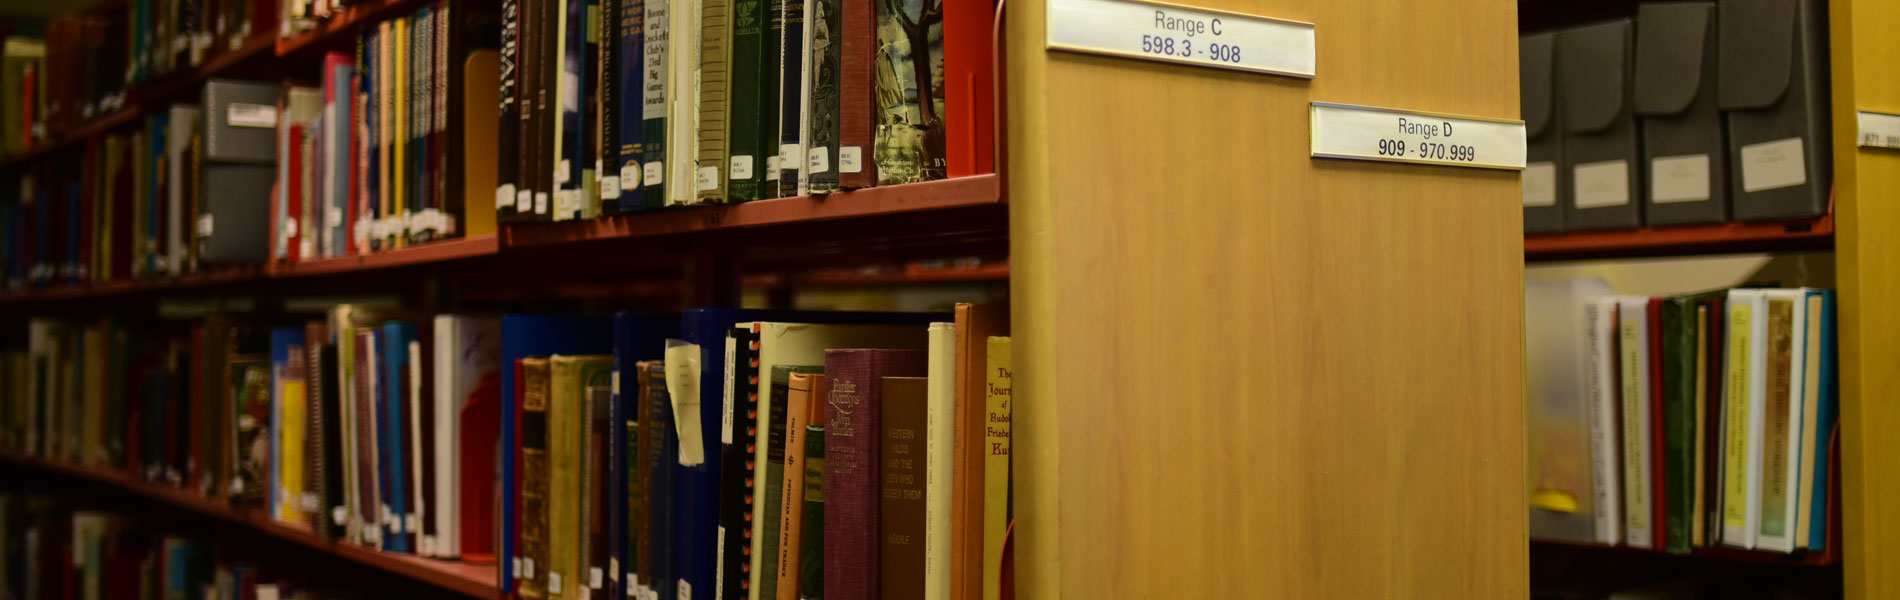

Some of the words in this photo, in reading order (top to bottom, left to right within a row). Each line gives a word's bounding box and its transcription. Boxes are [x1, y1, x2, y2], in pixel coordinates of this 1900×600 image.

[647, 9, 666, 19] Boone
[650, 19, 661, 30] and
[1154, 11, 1206, 35] Range
[1211, 18, 1223, 36] C
[645, 31, 669, 44] Crockett
[646, 44, 664, 56] Club's
[1142, 35, 1193, 58] 598.3
[1209, 40, 1242, 64] 908
[649, 70, 658, 81] Big
[646, 81, 663, 92] Game
[645, 92, 664, 105] Awards
[1398, 117, 1439, 138] Range
[1443, 121, 1453, 138] D
[1378, 139, 1406, 157] 909
[1419, 142, 1475, 163] 970.999
[934, 158, 946, 167] BY
[998, 367, 1012, 379] The
[1001, 400, 1008, 410] of
[987, 427, 1009, 438] Friede
[991, 442, 1009, 456] Ku
[901, 459, 913, 469] THE
[900, 474, 914, 485] WHO
[785, 478, 793, 514] PHYSICIAN
[903, 489, 921, 500] THEM
